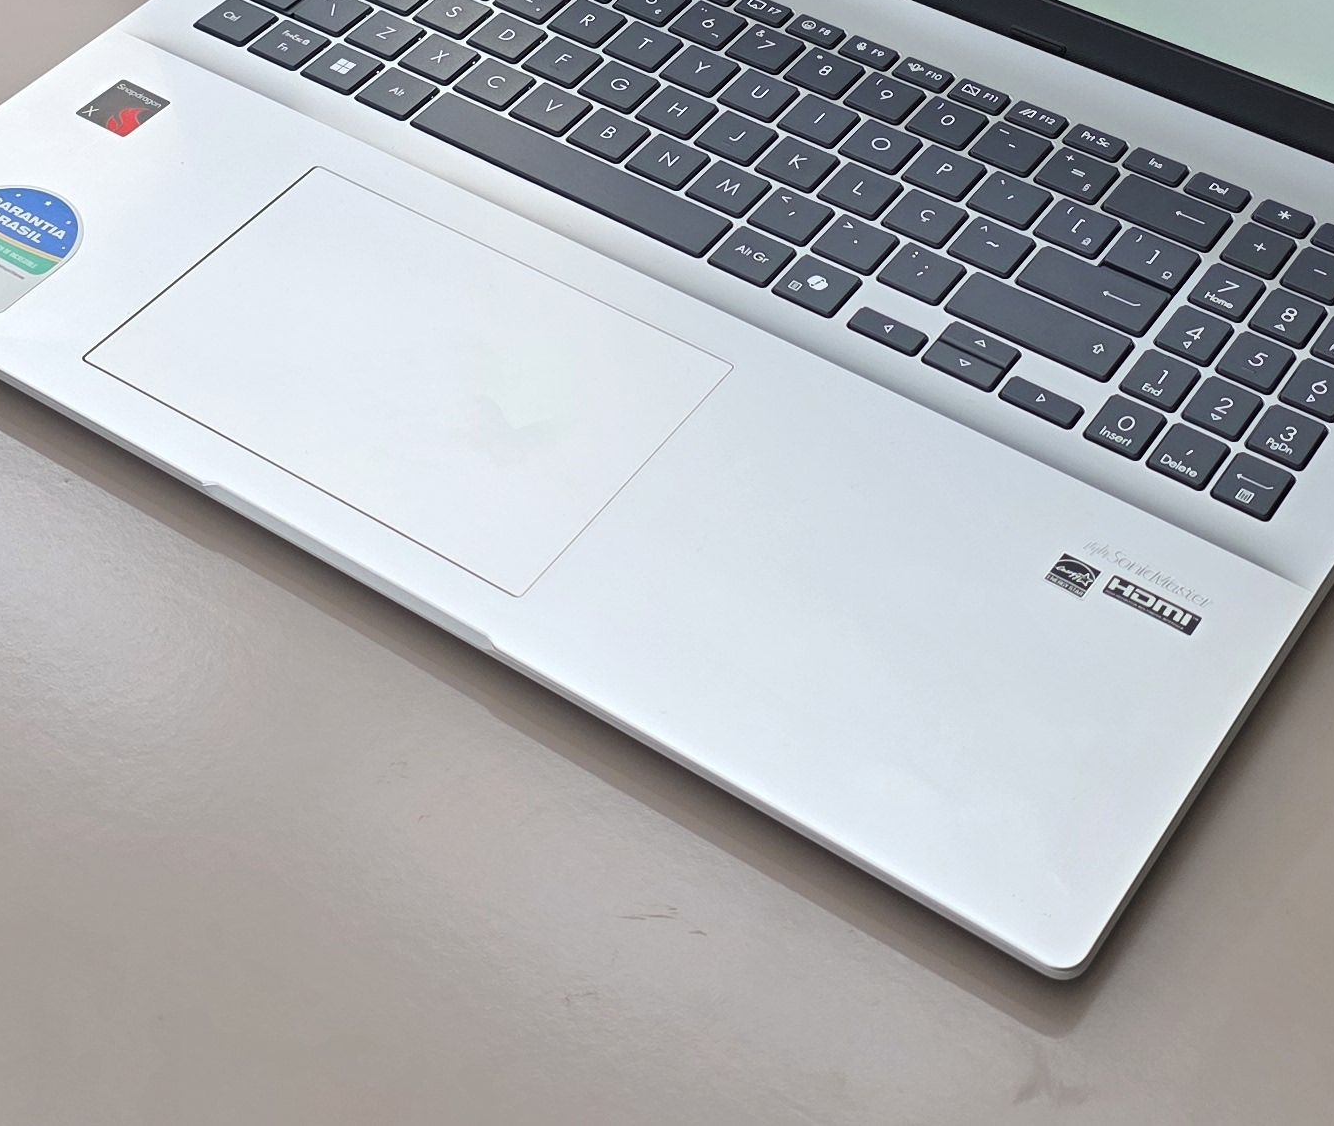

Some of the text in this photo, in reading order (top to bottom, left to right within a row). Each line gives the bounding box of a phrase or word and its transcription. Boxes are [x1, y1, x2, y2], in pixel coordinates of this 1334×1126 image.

[446, 7, 461, 17] S
[580, 14, 595, 26] R
[376, 27, 396, 39] Z
[498, 29, 515, 40] D
[277, 43, 288, 51] Fn
[638, 38, 653, 49] T
[431, 50, 449, 63] X
[555, 54, 572, 63] F
[695, 61, 710, 73] Y
[488, 76, 505, 88] C
[611, 79, 629, 90] G
[117, 83, 162, 109] Snapdragon
[389, 87, 404, 96] Alt
[751, 86, 769, 98] U
[81, 105, 100, 117] X
[546, 100, 563, 111] V
[667, 103, 688, 116] H
[600, 126, 616, 138] B
[729, 132, 746, 141] J
[659, 152, 679, 167] N
[788, 154, 807, 169] K
[1149, 158, 1162, 168] Ins
[936, 163, 952, 174] P
[716, 179, 740, 195] M
[853, 181, 863, 195] L
[1209, 183, 1228, 195] Del
[921, 210, 935, 222] Ç
[735, 245, 769, 263] Alt Gr
[1218, 281, 1239, 292] 7
[1204, 290, 1234, 310] Home
[1281, 308, 1297, 322] 8
[1184, 326, 1205, 342] 4
[1248, 353, 1266, 366] 5
[1158, 370, 1168, 384] 1
[1141, 381, 1163, 397] End
[1310, 379, 1329, 395] 6
[1214, 397, 1234, 414] 2
[1099, 427, 1133, 447] Insert
[1280, 427, 1297, 441] 3
[1265, 437, 1293, 455] PgDn
[1160, 454, 1198, 479] Delete
[1108, 577, 1193, 626] HDMI
